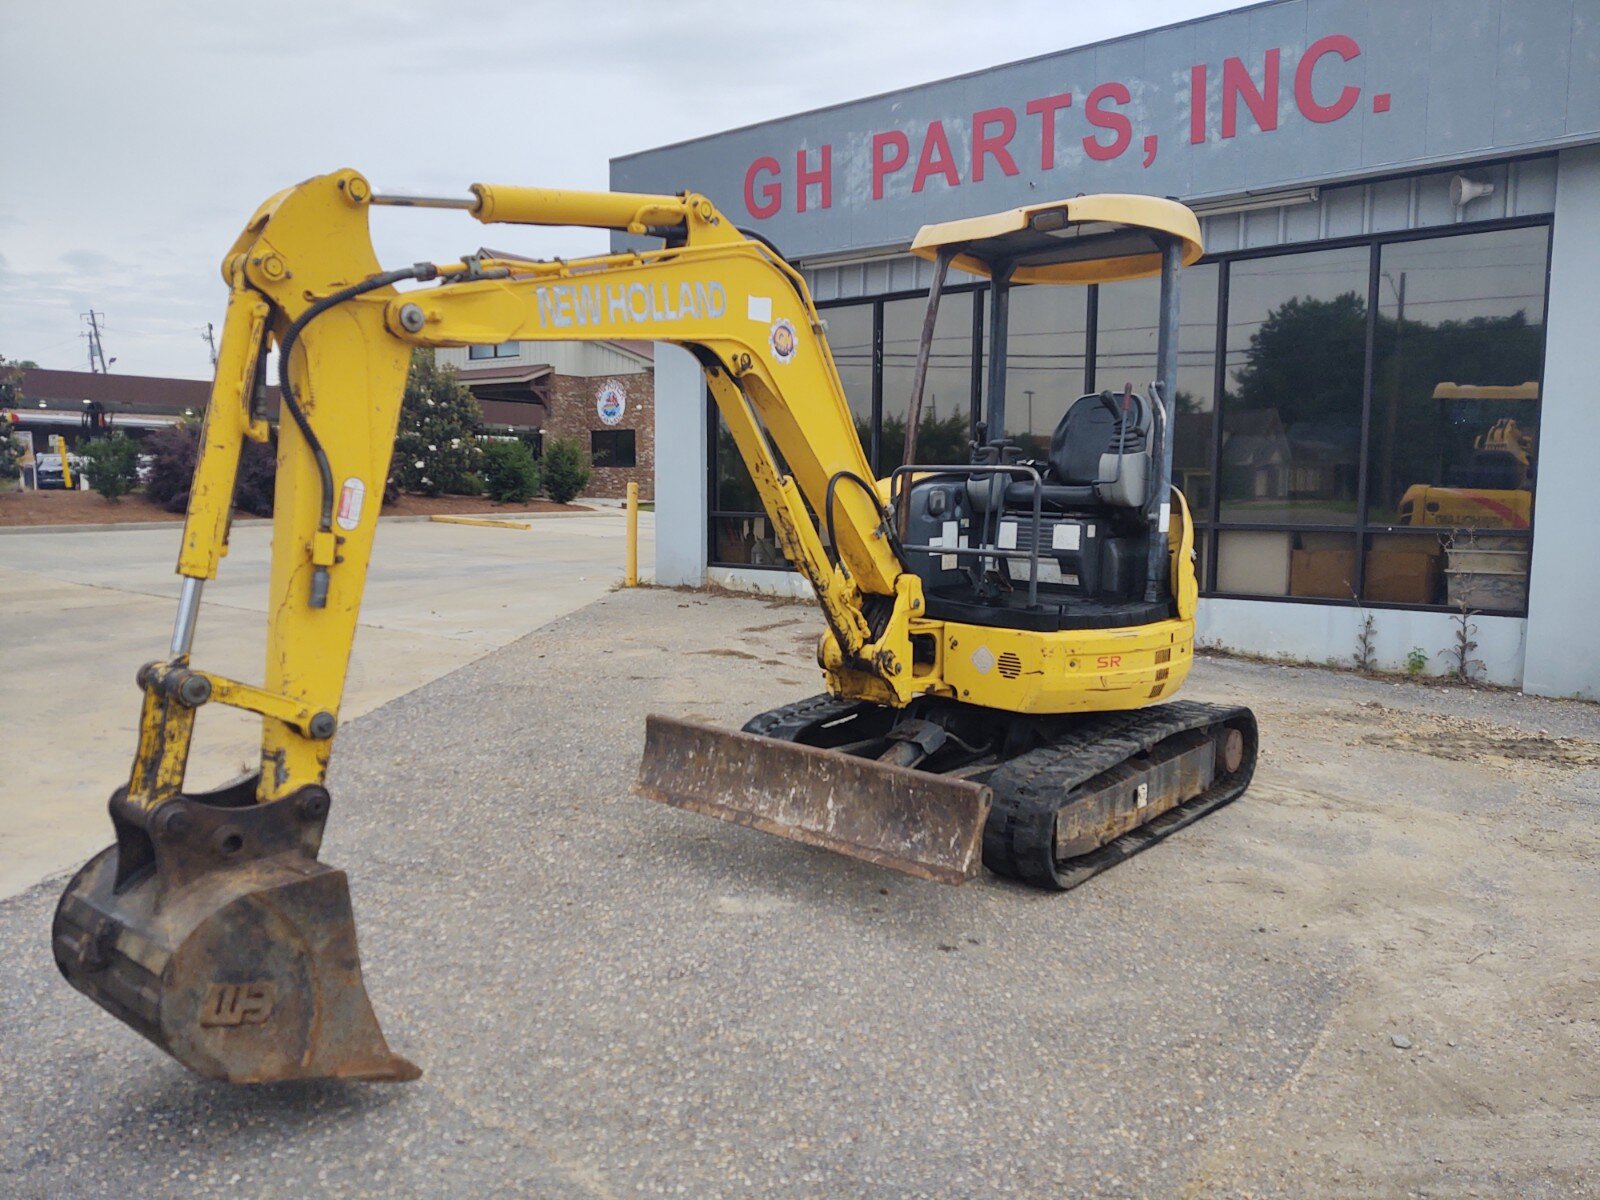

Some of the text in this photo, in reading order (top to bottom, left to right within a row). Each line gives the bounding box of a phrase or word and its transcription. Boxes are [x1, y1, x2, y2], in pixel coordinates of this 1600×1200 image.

[744, 34, 1391, 220] GH PARTS, INC.
[536, 281, 727, 328] NEW HOLLAND
[1097, 655, 1121, 668] SR
